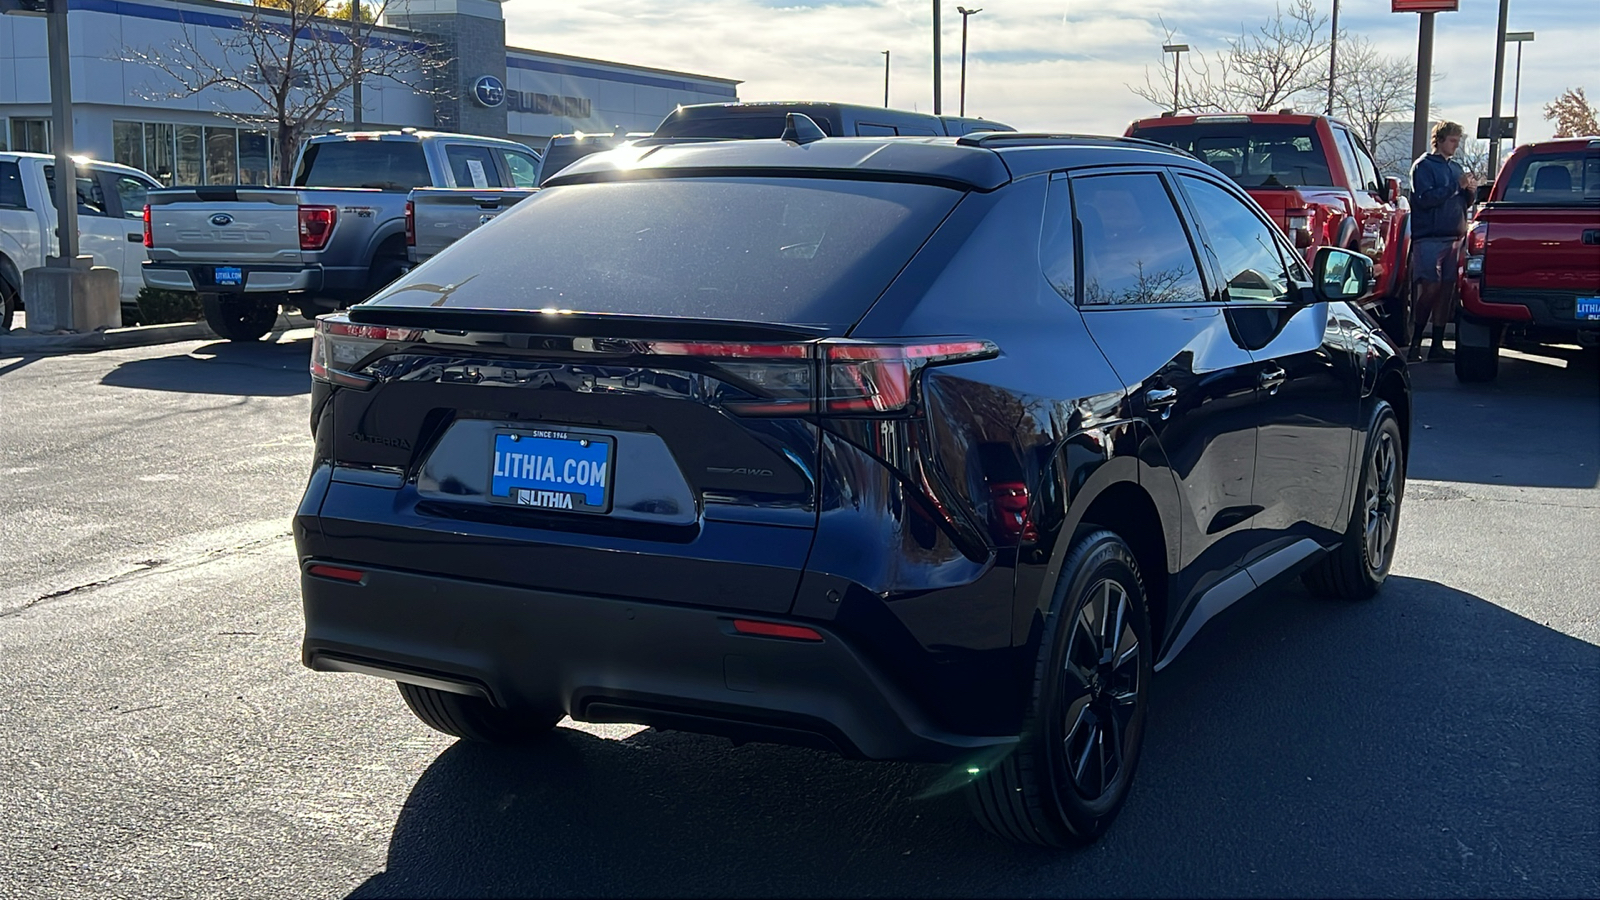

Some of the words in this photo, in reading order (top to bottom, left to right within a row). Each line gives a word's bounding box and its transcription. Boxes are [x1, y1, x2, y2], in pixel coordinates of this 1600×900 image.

[506, 89, 591, 118] SUBARU
[176, 229, 271, 243] F-150
[429, 365, 640, 389] SUBARU
[533, 430, 551, 438] SINCE
[553, 431, 568, 439] 1946
[494, 451, 607, 488] LITHIA.COM
[732, 467, 774, 477] AWD
[530, 490, 573, 509] LITHIA
